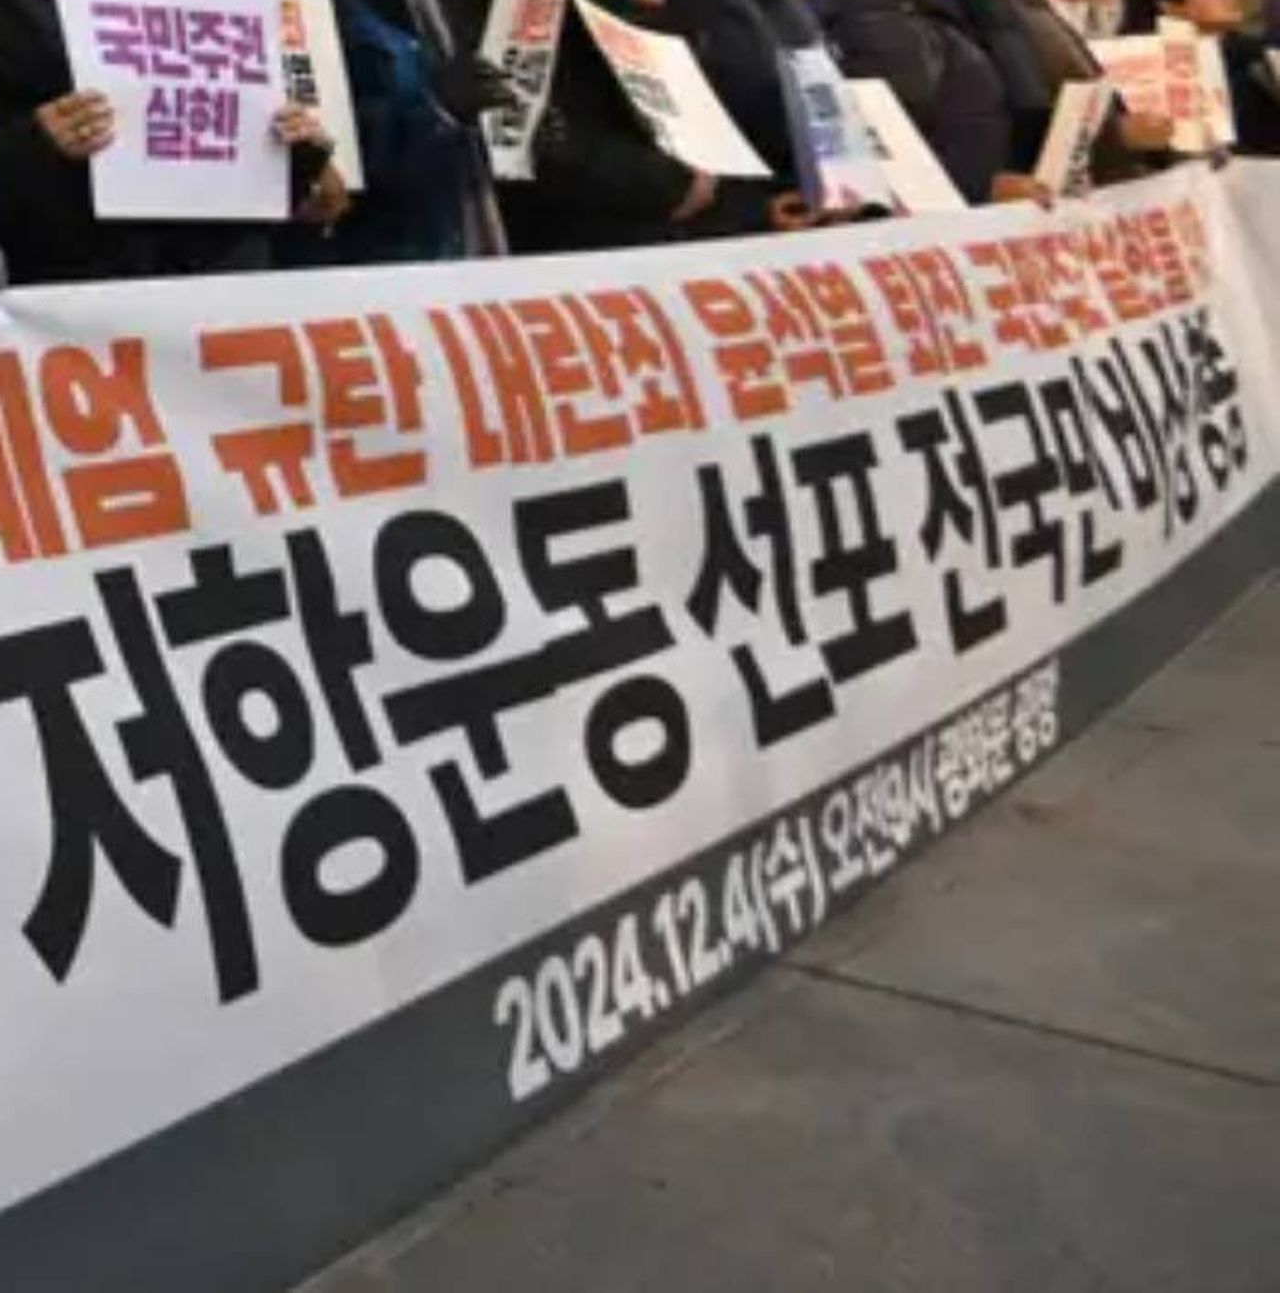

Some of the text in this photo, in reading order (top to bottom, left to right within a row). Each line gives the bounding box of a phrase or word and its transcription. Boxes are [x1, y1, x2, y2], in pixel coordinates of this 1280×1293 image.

[90, 2, 270, 85] 국민주권
[199, 311, 428, 517] 규탄
[425, 284, 707, 469] 내란죄
[681, 260, 895, 423] 윤석열
[685, 433, 918, 750] 선포
[896, 355, 1124, 654] 전국민
